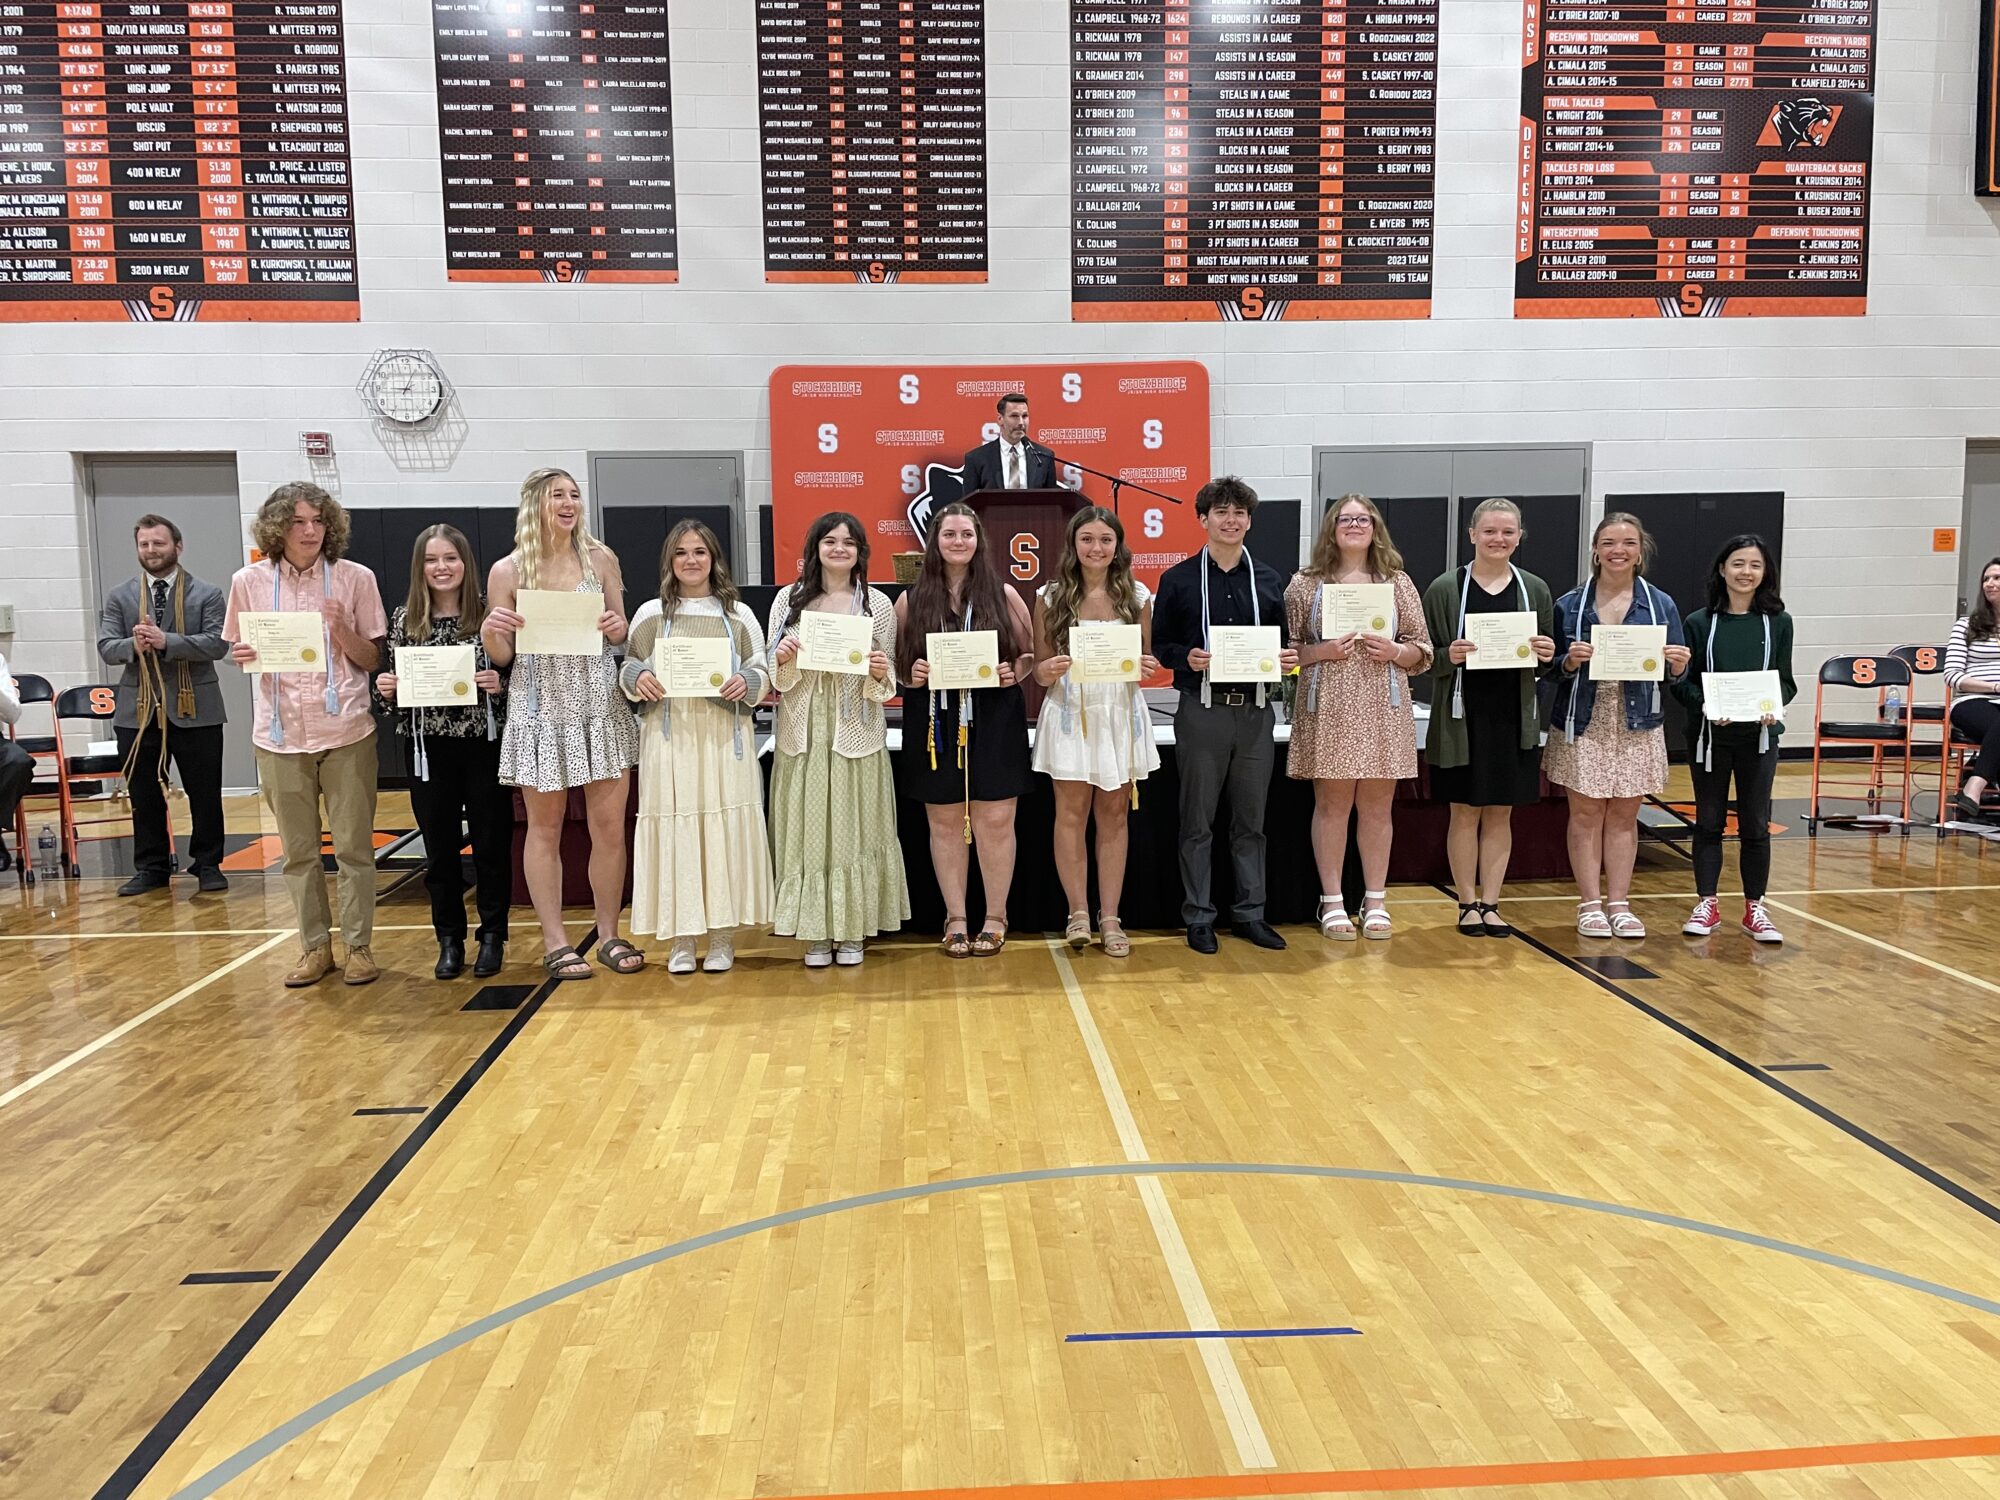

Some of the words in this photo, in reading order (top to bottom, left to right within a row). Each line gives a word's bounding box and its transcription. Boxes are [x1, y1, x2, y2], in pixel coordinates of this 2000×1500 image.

[130, 6, 151, 15] 3200
[153, 6, 160, 15] M
[275, 6, 283, 15] R.
[286, 6, 315, 15] TOLSON
[318, 6, 336, 14] 2019
[1076, 14, 1083, 24] J.
[1085, 14, 1126, 24] CAMPBELL
[1131, 14, 1160, 24] 1968-72
[1168, 14, 1185, 23] 1624
[68, 26, 90, 35] 14.30
[106, 25, 138, 35] 100/110
[140, 25, 147, 35] M
[150, 25, 185, 35] HURDLES
[269, 25, 278, 35] M.
[281, 25, 315, 35] MITTEER
[318, 25, 336, 35] 1993
[1076, 33, 1083, 43] B.
[1085, 33, 1120, 43] RICKMAN
[1124, 33, 1142, 43] 1978
[1549, 33, 1587, 42] RECEIVING
[1591, 33, 1639, 42] TOUCHDOWNS
[1805, 36, 1842, 44] RECEIVING
[1844, 37, 1867, 45] YARDS
[294, 45, 302, 54] G.
[305, 45, 338, 54] ROBIDOU
[1549, 46, 1556, 55] A.
[1559, 46, 1587, 55] CIMALA
[1590, 46, 1608, 55] 2014
[1676, 47, 1681, 55] 5
[1699, 47, 1720, 55] GAME
[1734, 47, 1747, 55] 273
[1076, 71, 1083, 80] K.
[1086, 71, 1123, 80] GRAMMER
[1126, 71, 1144, 80] 2014
[1215, 71, 1246, 81] ASSISTS
[1248, 71, 1256, 81] IN
[1258, 71, 1263, 81] A
[1266, 71, 1296, 81] CAREER
[1362, 71, 1370, 81] S.
[1372, 71, 1400, 81] CASKEY
[1404, 71, 1433, 81] 1997-00
[1220, 90, 1248, 100] STEALS
[1251, 90, 1258, 100] IN
[1260, 90, 1266, 100] A
[1268, 90, 1290, 100] GAME
[1548, 98, 1569, 107] TOTAL
[1572, 98, 1604, 107] TACKLES
[126, 103, 147, 112] POLE
[150, 103, 174, 112] VAULT
[276, 104, 284, 113] C.
[286, 104, 319, 113] WATSON
[321, 104, 342, 113] 2008
[1546, 111, 1553, 120] C.
[1556, 111, 1584, 120] WRIGHT
[1586, 111, 1604, 120] 2016
[1672, 112, 1680, 120] 29
[268, 142, 278, 152] M.
[280, 142, 321, 152] TEACHOUT
[324, 142, 344, 152] 2020
[270, 162, 278, 171] R.
[280, 162, 306, 171] PRICE,
[308, 162, 316, 171] J.
[318, 162, 346, 171] LISTER
[1546, 164, 1577, 173] TACKLES
[1580, 164, 1593, 173] FOR
[1596, 164, 1614, 173] LOSS
[1786, 164, 1836, 173] QUARTERBACK
[1838, 164, 1862, 173] SACKS
[127, 168, 143, 177] 400
[146, 168, 153, 177] M
[156, 168, 181, 177] RELAY
[1544, 191, 1551, 200] J.
[1554, 191, 1586, 200] HAMBLIN
[1588, 191, 1605, 200] 2010
[1671, 192, 1677, 200] 11
[1690, 192, 1718, 200] SEASON
[1732, 192, 1739, 200] 12
[1795, 192, 1802, 201] K.
[1804, 192, 1841, 201] KRUSINSKI
[1844, 192, 1860, 201] 2014
[1208, 219, 1213, 229] 3
[1216, 219, 1224, 229] PT
[1227, 219, 1250, 229] SHOTS
[1252, 219, 1259, 229] IN
[1262, 219, 1267, 229] A
[1270, 219, 1299, 229] SEASON
[1327, 220, 1334, 228] 51
[1370, 219, 1377, 228] E.
[1380, 219, 1406, 228] MYERS
[1412, 219, 1429, 228] 1995
[1543, 228, 1598, 237] INTERCEPTIONS
[1771, 228, 1809, 237] DEFENSIVE
[1812, 228, 1859, 237] TOUCHDOWNS
[129, 233, 148, 243] 1600
[151, 233, 158, 243] M
[160, 233, 186, 243] RELAY
[557, 261, 571, 281] S
[870, 263, 884, 282] S
[1686, 271, 1715, 279] CAREER
[1788, 270, 1796, 279] C.
[1798, 270, 1828, 279] JENKINS
[1830, 270, 1857, 279] 2013-14
[1077, 275, 1093, 284] 1978
[1096, 275, 1116, 284] TEAM
[1170, 275, 1180, 284] 24
[1208, 274, 1228, 284] MOST
[1231, 274, 1249, 284] WINS
[1252, 274, 1258, 284] IN
[1261, 274, 1266, 284] A
[1269, 274, 1297, 284] SEASON
[1325, 274, 1334, 283] 22
[1388, 273, 1405, 282] 1985
[1408, 273, 1428, 282] TEAM
[150, 286, 174, 318] S
[1242, 287, 1264, 318] S
[1681, 284, 1703, 314] S
[792, 381, 862, 395] STOCKBRIDGE
[900, 374, 919, 404] S
[1062, 373, 1082, 402] S
[1119, 377, 1186, 393] STOCKBRIDGE
[818, 423, 838, 453] S
[876, 430, 944, 444] STOCKBRIDGE
[1038, 428, 1106, 443] STOCKBRIDGE
[1143, 419, 1162, 449] S
[795, 472, 863, 486] STOCKBRIDGE
[901, 464, 921, 494] S
[1120, 467, 1186, 482] STOCKBRIDGE
[1144, 508, 1163, 538] S
[1010, 532, 1039, 580] S
[1916, 648, 1937, 670] S
[1853, 658, 1876, 684] S
[90, 688, 115, 714] S
